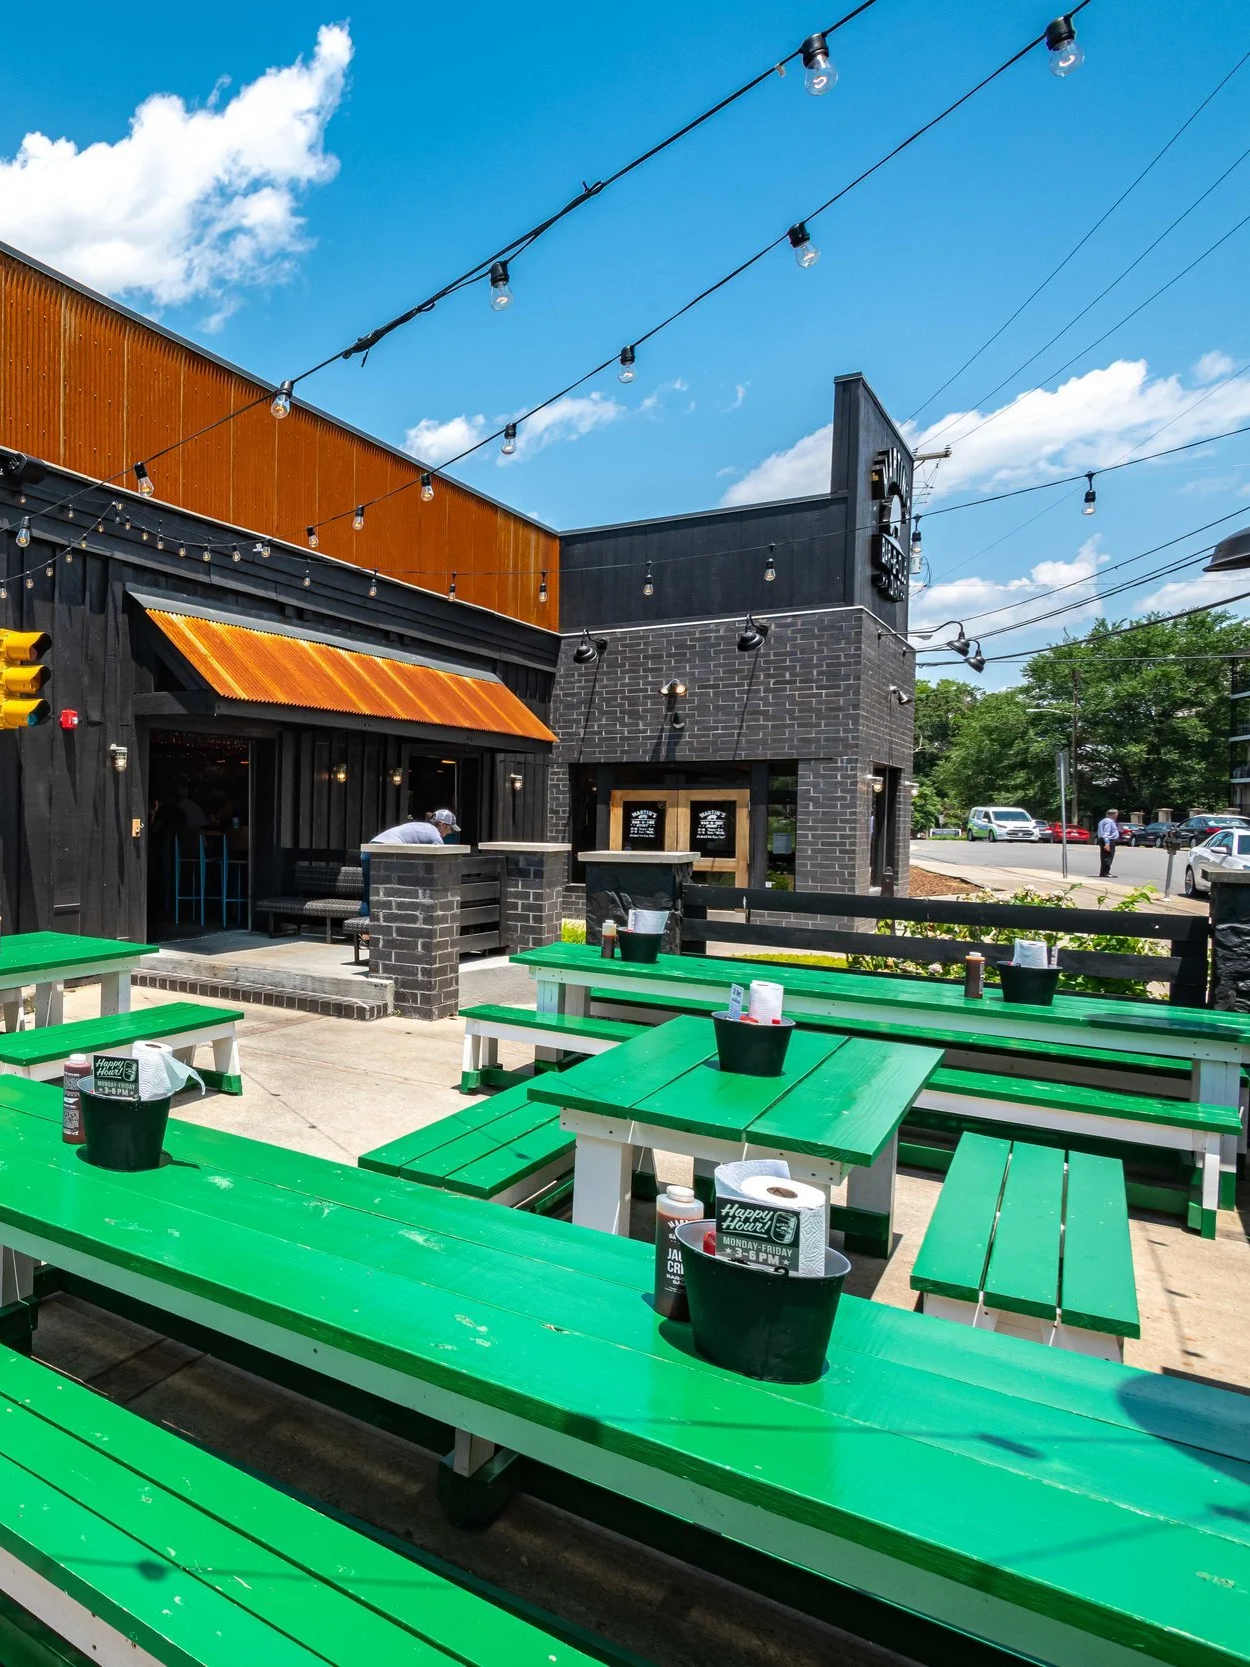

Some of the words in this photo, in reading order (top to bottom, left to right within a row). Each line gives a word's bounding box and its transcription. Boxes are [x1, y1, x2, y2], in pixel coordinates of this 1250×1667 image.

[631, 810, 658, 818] MARTIN'S
[698, 810, 726, 818] MARTIN'S
[95, 1058, 124, 1070] Happy
[96, 1067, 124, 1076] Hour!
[97, 1080, 136, 1090] MONDAY-FRIDAY
[104, 1086, 117, 1095] 3-6
[117, 1088, 129, 1096] PM
[721, 1203, 774, 1223] Happy
[721, 1217, 770, 1233] Hour!
[722, 1236, 793, 1258] MONDAY-FRIDAY
[735, 1247, 757, 1261] 3-6
[759, 1253, 779, 1266] PM
